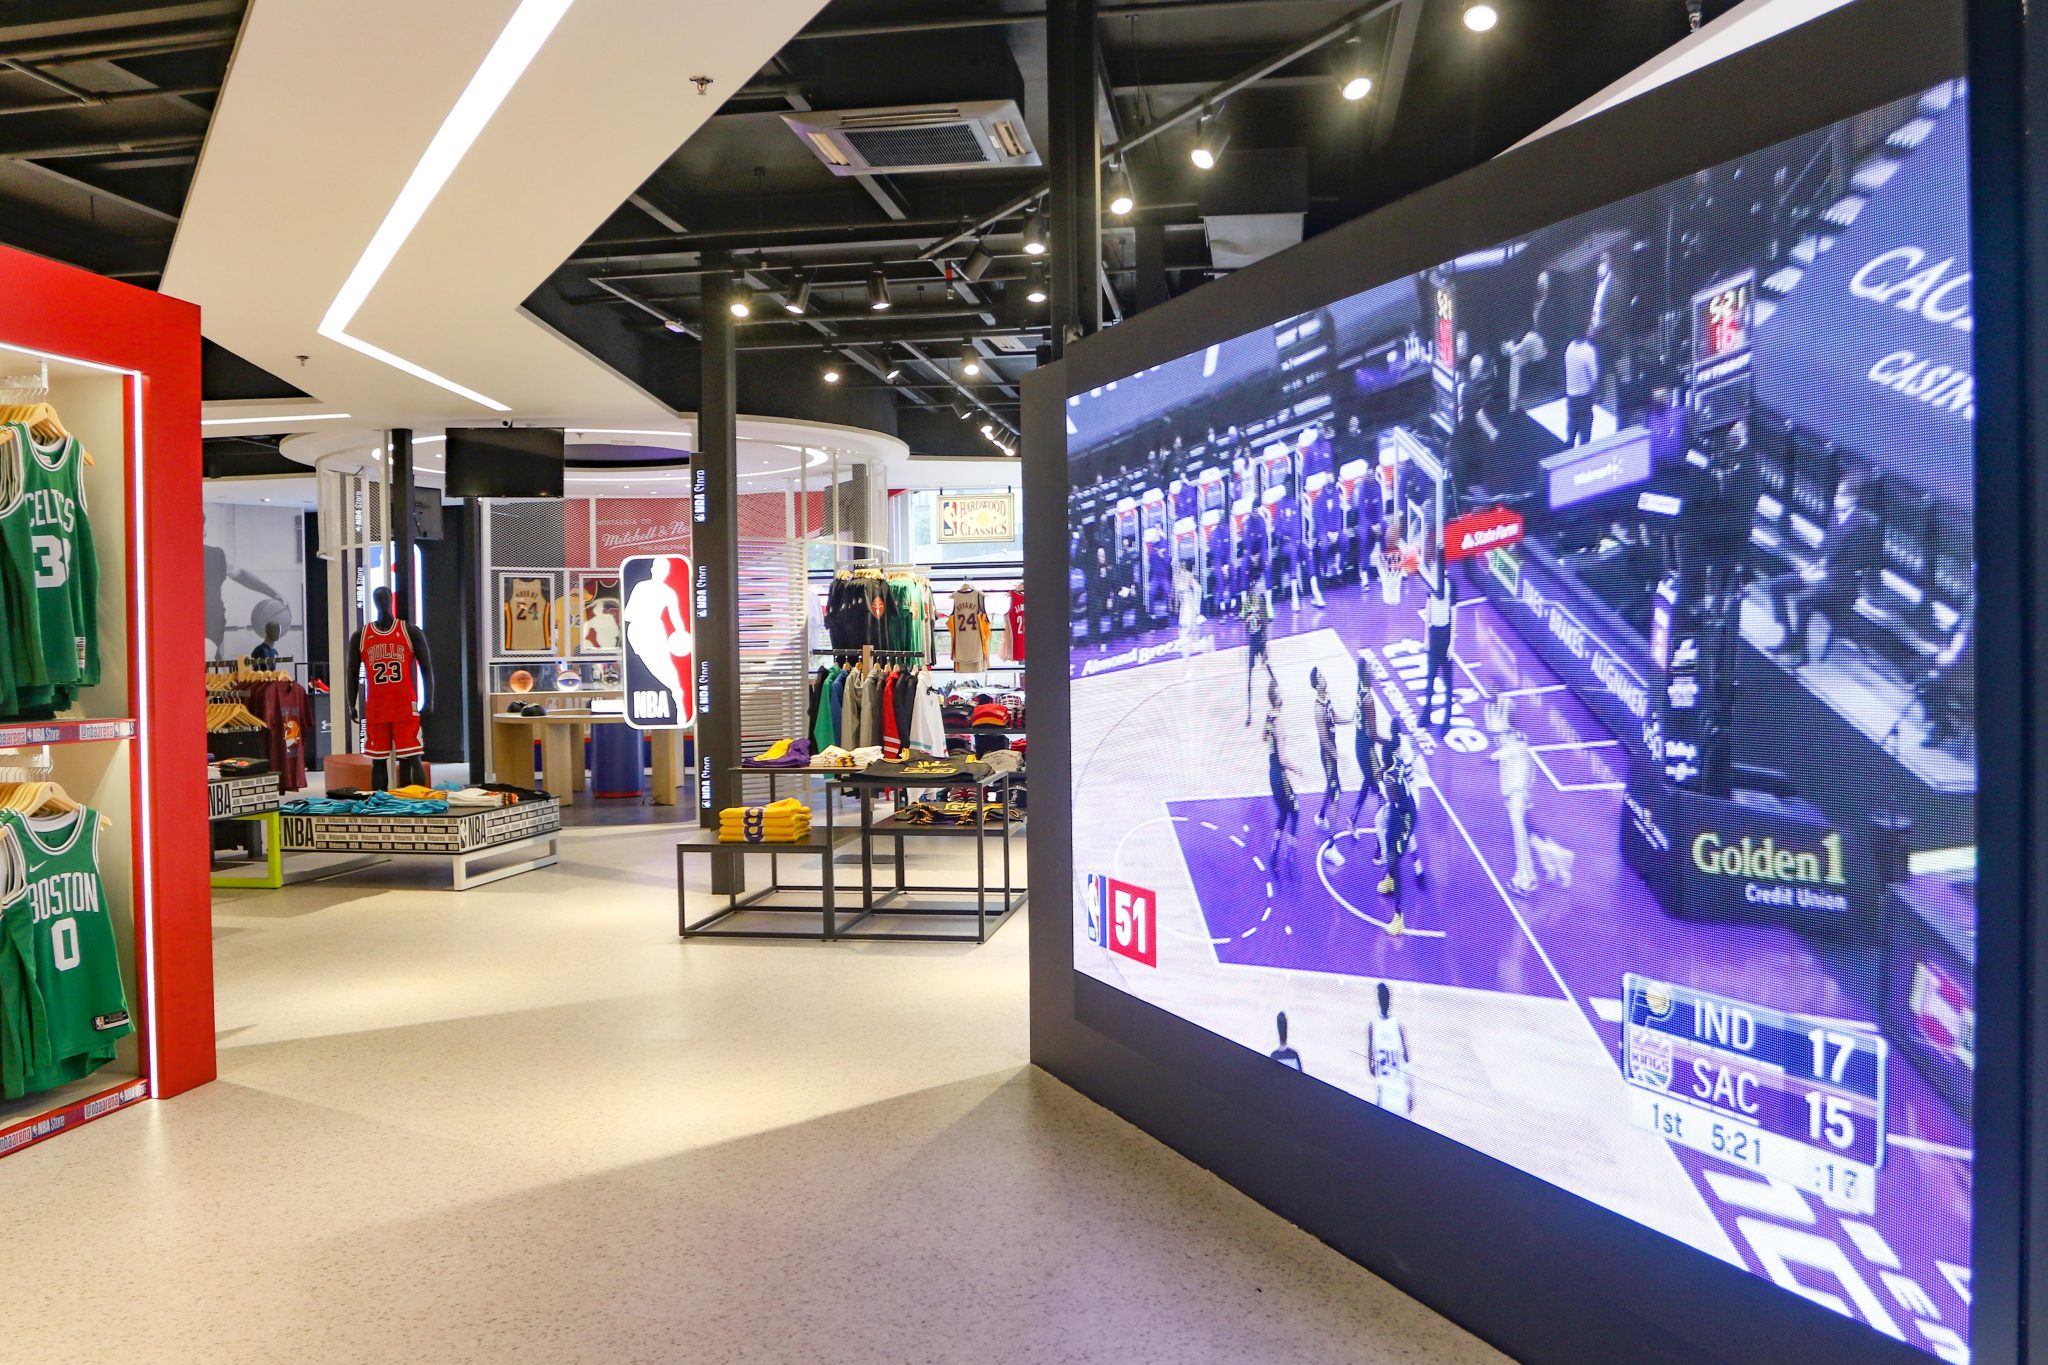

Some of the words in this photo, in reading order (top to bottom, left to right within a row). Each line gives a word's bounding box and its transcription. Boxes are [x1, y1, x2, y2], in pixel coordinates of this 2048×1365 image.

[1850, 246, 1973, 331] CAC
[960, 501, 1007, 517] HARDWOOD
[960, 520, 1007, 536] CLASSICS
[958, 613, 977, 632] 24
[373, 661, 403, 684] 23
[1081, 647, 1138, 676] Almond
[633, 691, 671, 719] NBA
[209, 784, 231, 817] NBA
[283, 817, 315, 847] NBA
[468, 814, 486, 847] NBA
[27, 871, 100, 924] BOSTON
[1744, 882, 1794, 906] Credit
[1796, 886, 1849, 912] Union
[1114, 889, 1146, 955] 51
[51, 916, 81, 972] 0
[1694, 999, 1755, 1050] IND
[1808, 1028, 1855, 1083] 17
[1692, 1058, 1759, 1114] SAC
[1805, 1090, 1855, 1149] 15
[1652, 1102, 1683, 1138] 1st
[1711, 1123, 1761, 1165] 5:21
